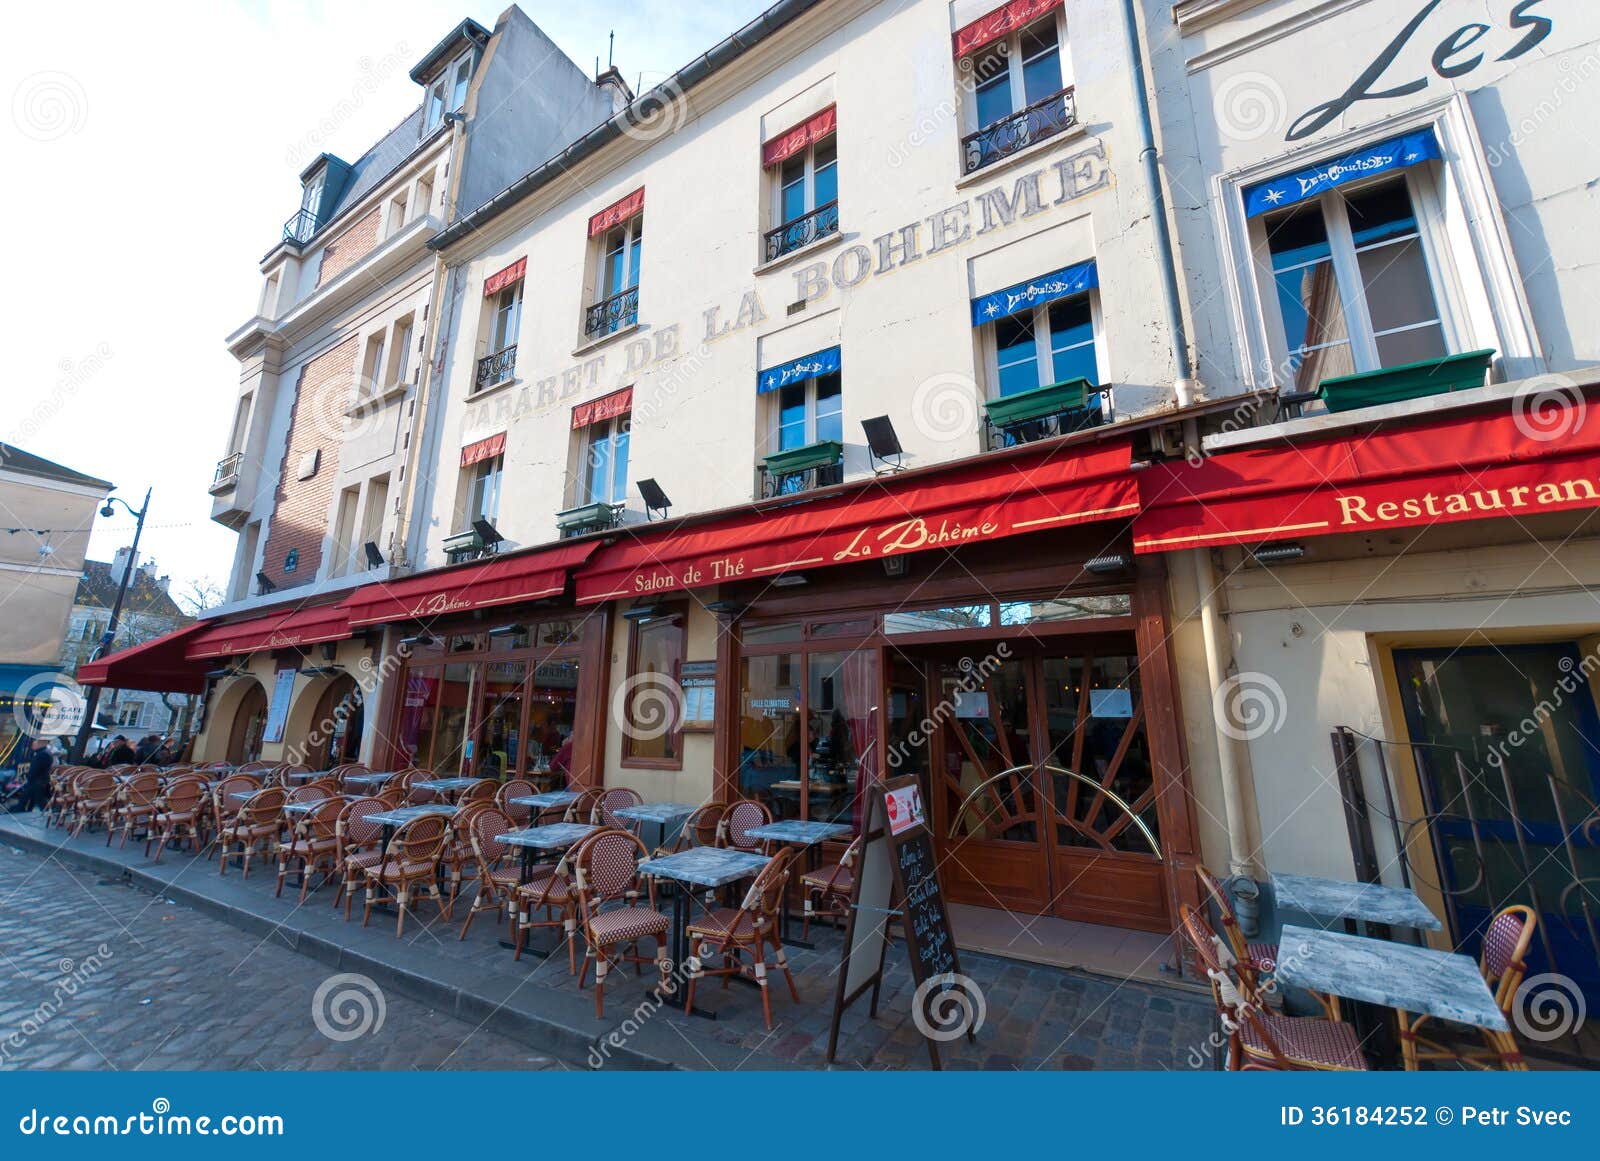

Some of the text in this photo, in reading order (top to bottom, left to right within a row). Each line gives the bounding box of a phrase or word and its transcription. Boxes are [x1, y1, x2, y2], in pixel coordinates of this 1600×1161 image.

[1284, 0, 1552, 141] Les
[623, 322, 681, 374] DE
[701, 288, 768, 344] LA
[791, 147, 1112, 304] BOHEME
[1336, 477, 1600, 526] Restauran
[833, 517, 999, 561] La Bohème
[634, 558, 745, 592] Salon de Thé
[410, 596, 425, 616] La
